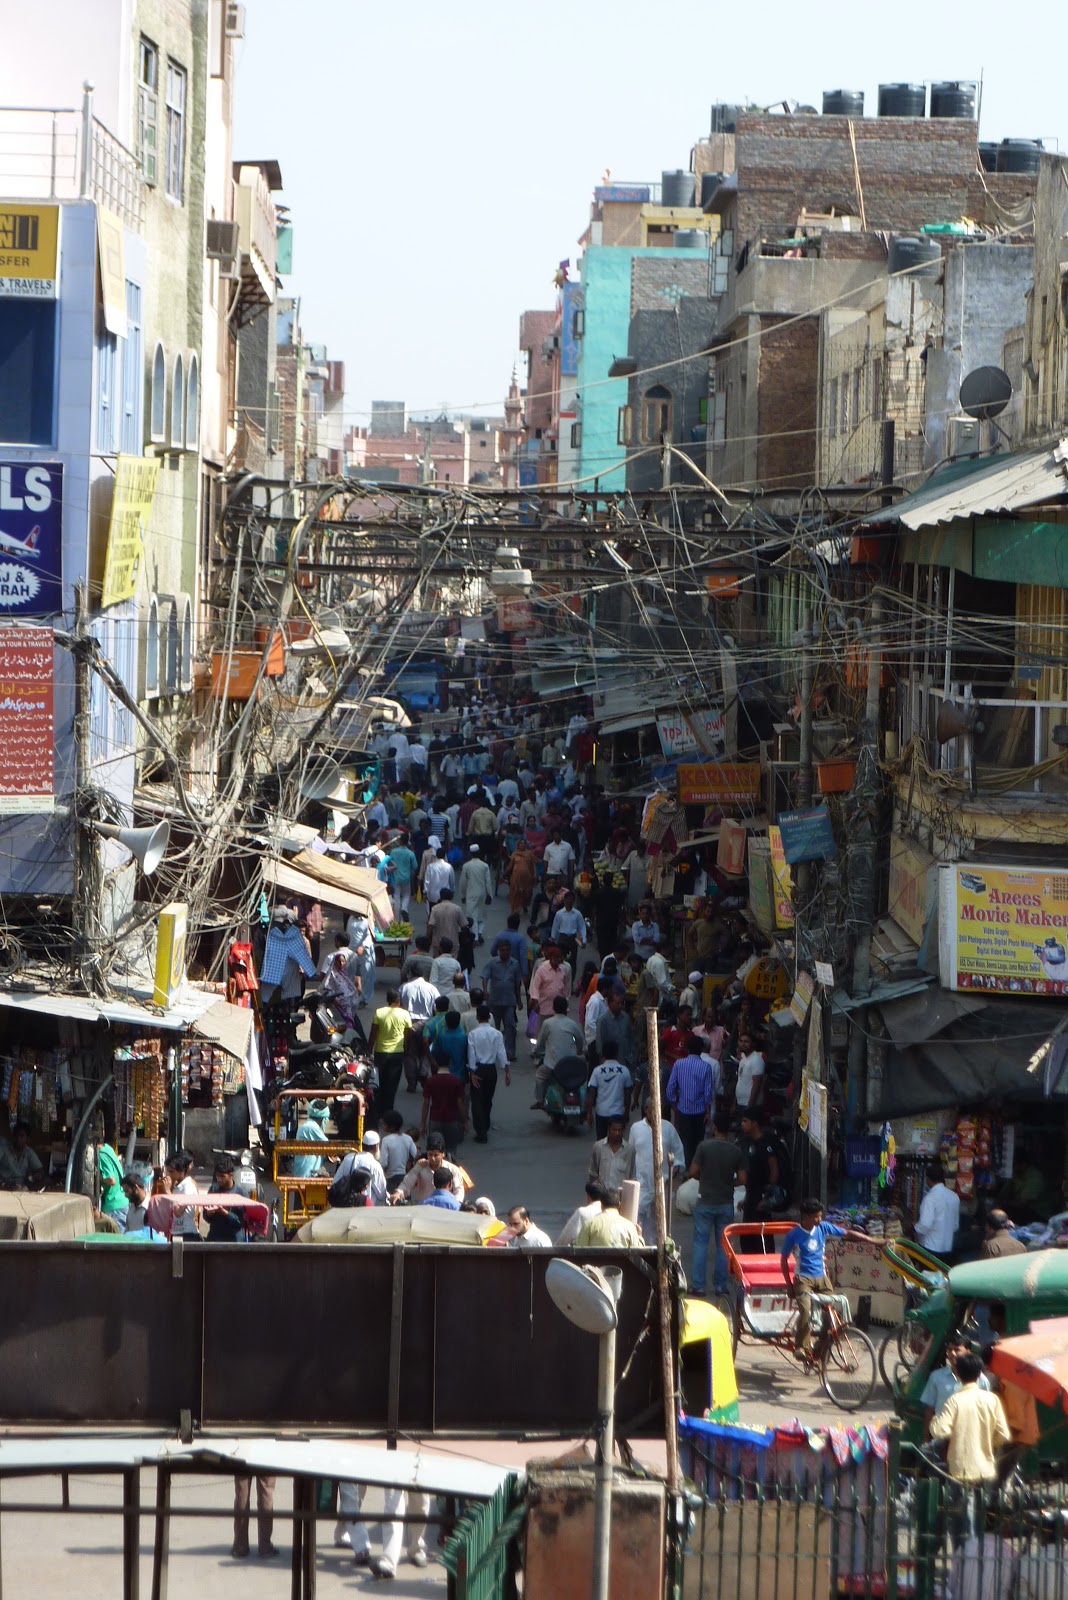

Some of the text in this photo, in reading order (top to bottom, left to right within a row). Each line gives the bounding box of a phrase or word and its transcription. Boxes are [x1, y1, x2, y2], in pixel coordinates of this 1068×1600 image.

[8, 278, 52, 290] TRAVELS
[0, 465, 52, 512] LS
[15, 571, 26, 583] &
[662, 726, 682, 741] TOP
[691, 792, 757, 800] INSIDE STREET
[989, 888, 1041, 907] Anees
[960, 904, 1011, 924] Movie
[983, 927, 1009, 937] Video Graphy
[959, 934, 967, 943] Still
[994, 937, 1007, 947] Digital
[1008, 939, 1020, 947] Photo
[1020, 939, 1034, 949] Mixing
[976, 946, 1016, 958] Digital Video Mixing
